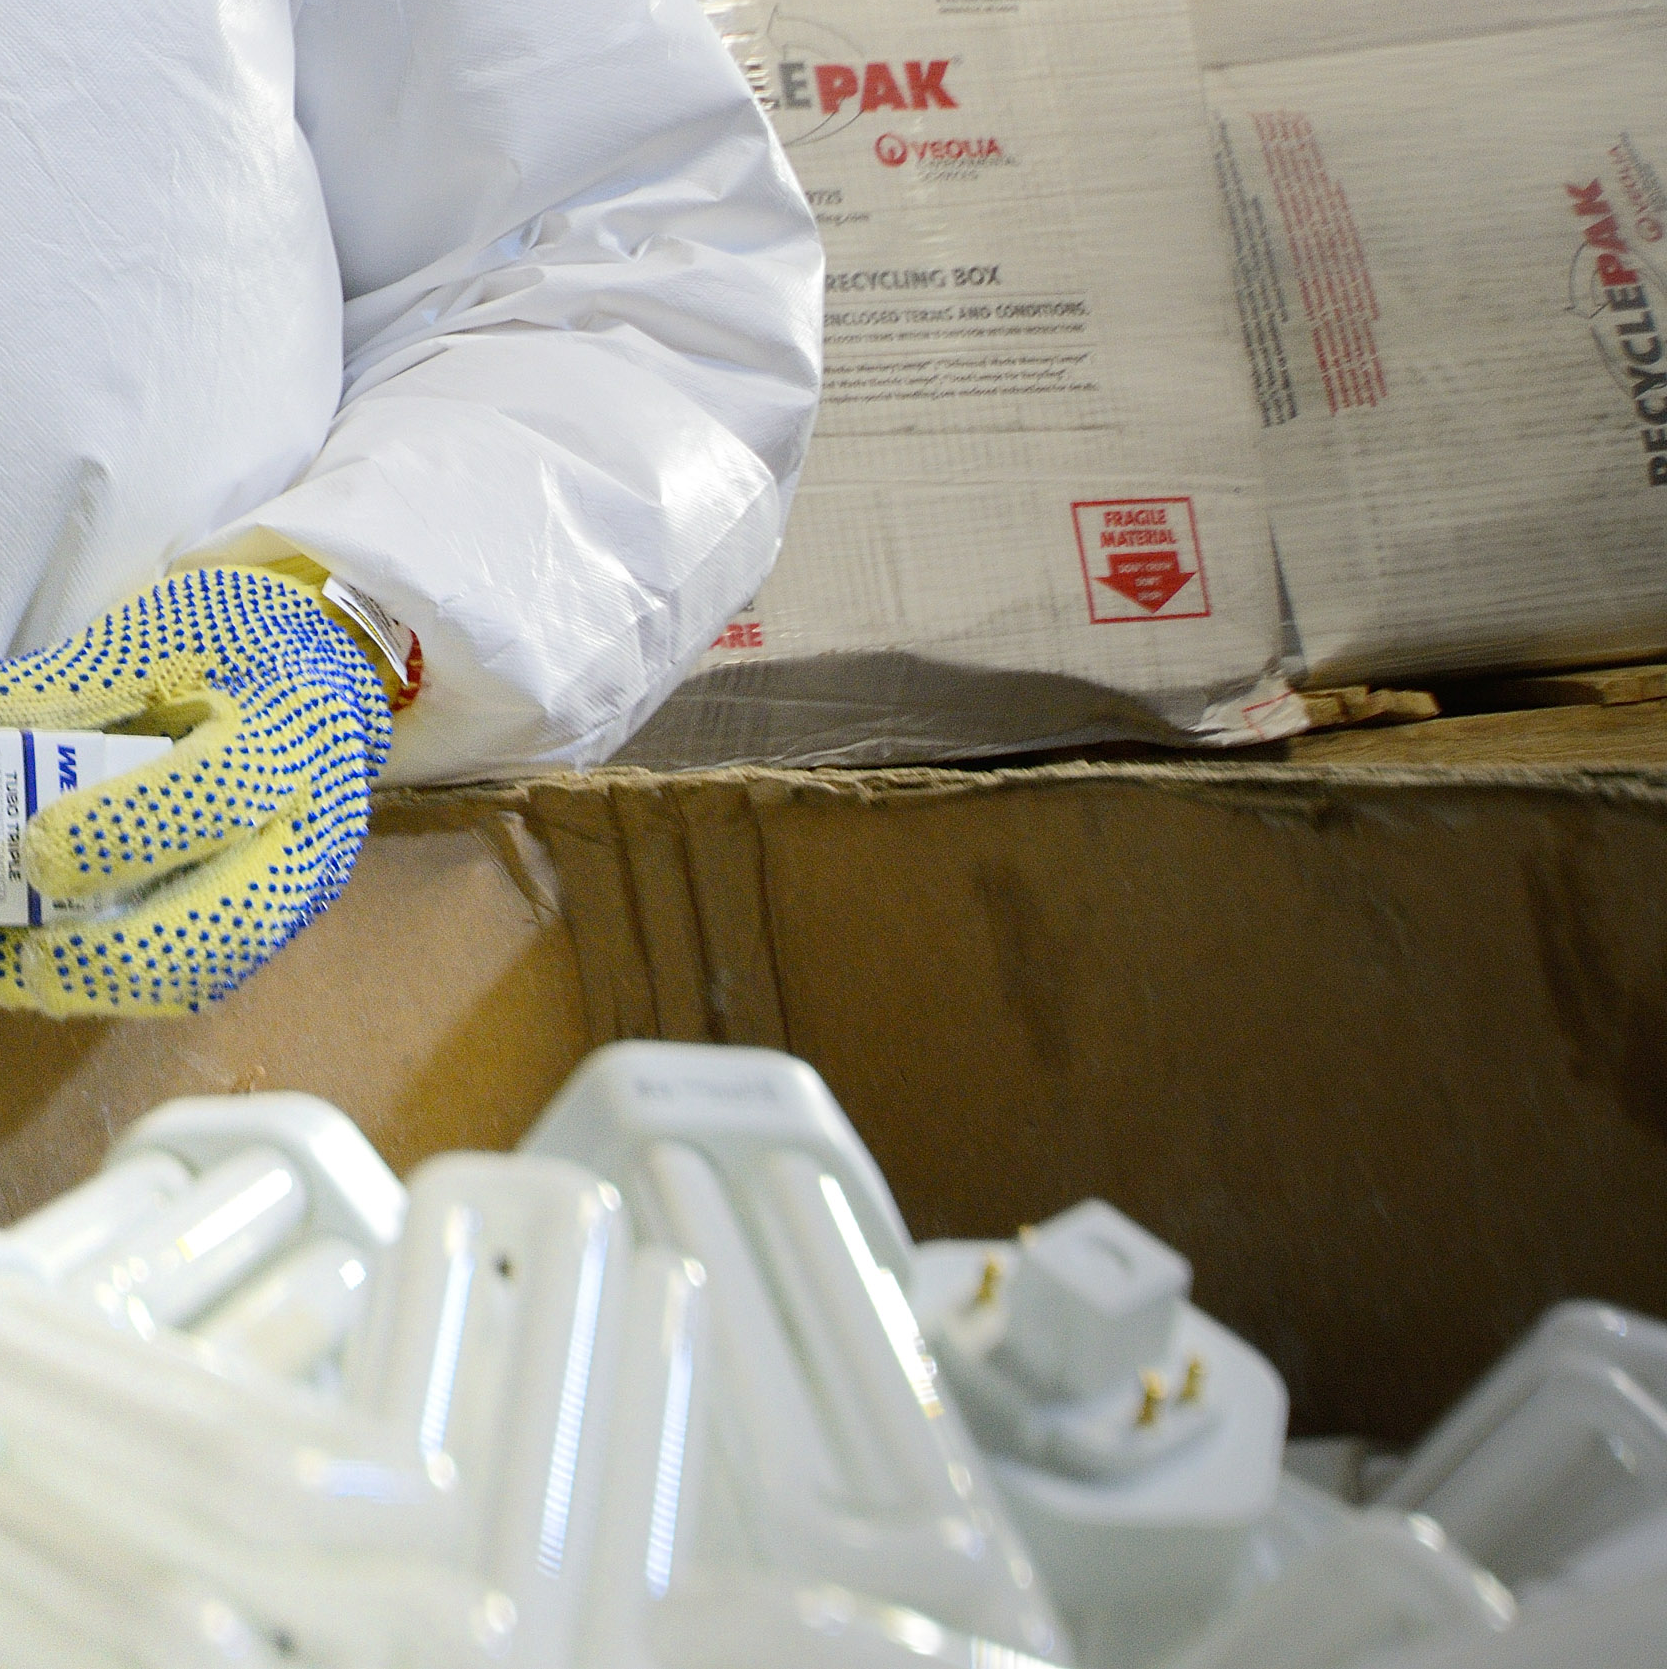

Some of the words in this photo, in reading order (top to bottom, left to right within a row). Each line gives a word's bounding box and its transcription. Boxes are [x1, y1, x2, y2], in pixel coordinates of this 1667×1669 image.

[825, 268, 946, 293] RECYCLING
[951, 263, 1002, 287] BOX
[904, 307, 953, 324] TERMS
[958, 305, 991, 321] AND
[1103, 509, 1168, 528] FRAGILE
[1100, 529, 1177, 548] MATERIAL
[708, 623, 763, 650] ARE
[6, 771, 19, 817] TUBO
[8, 822, 22, 883] TRIPLE
